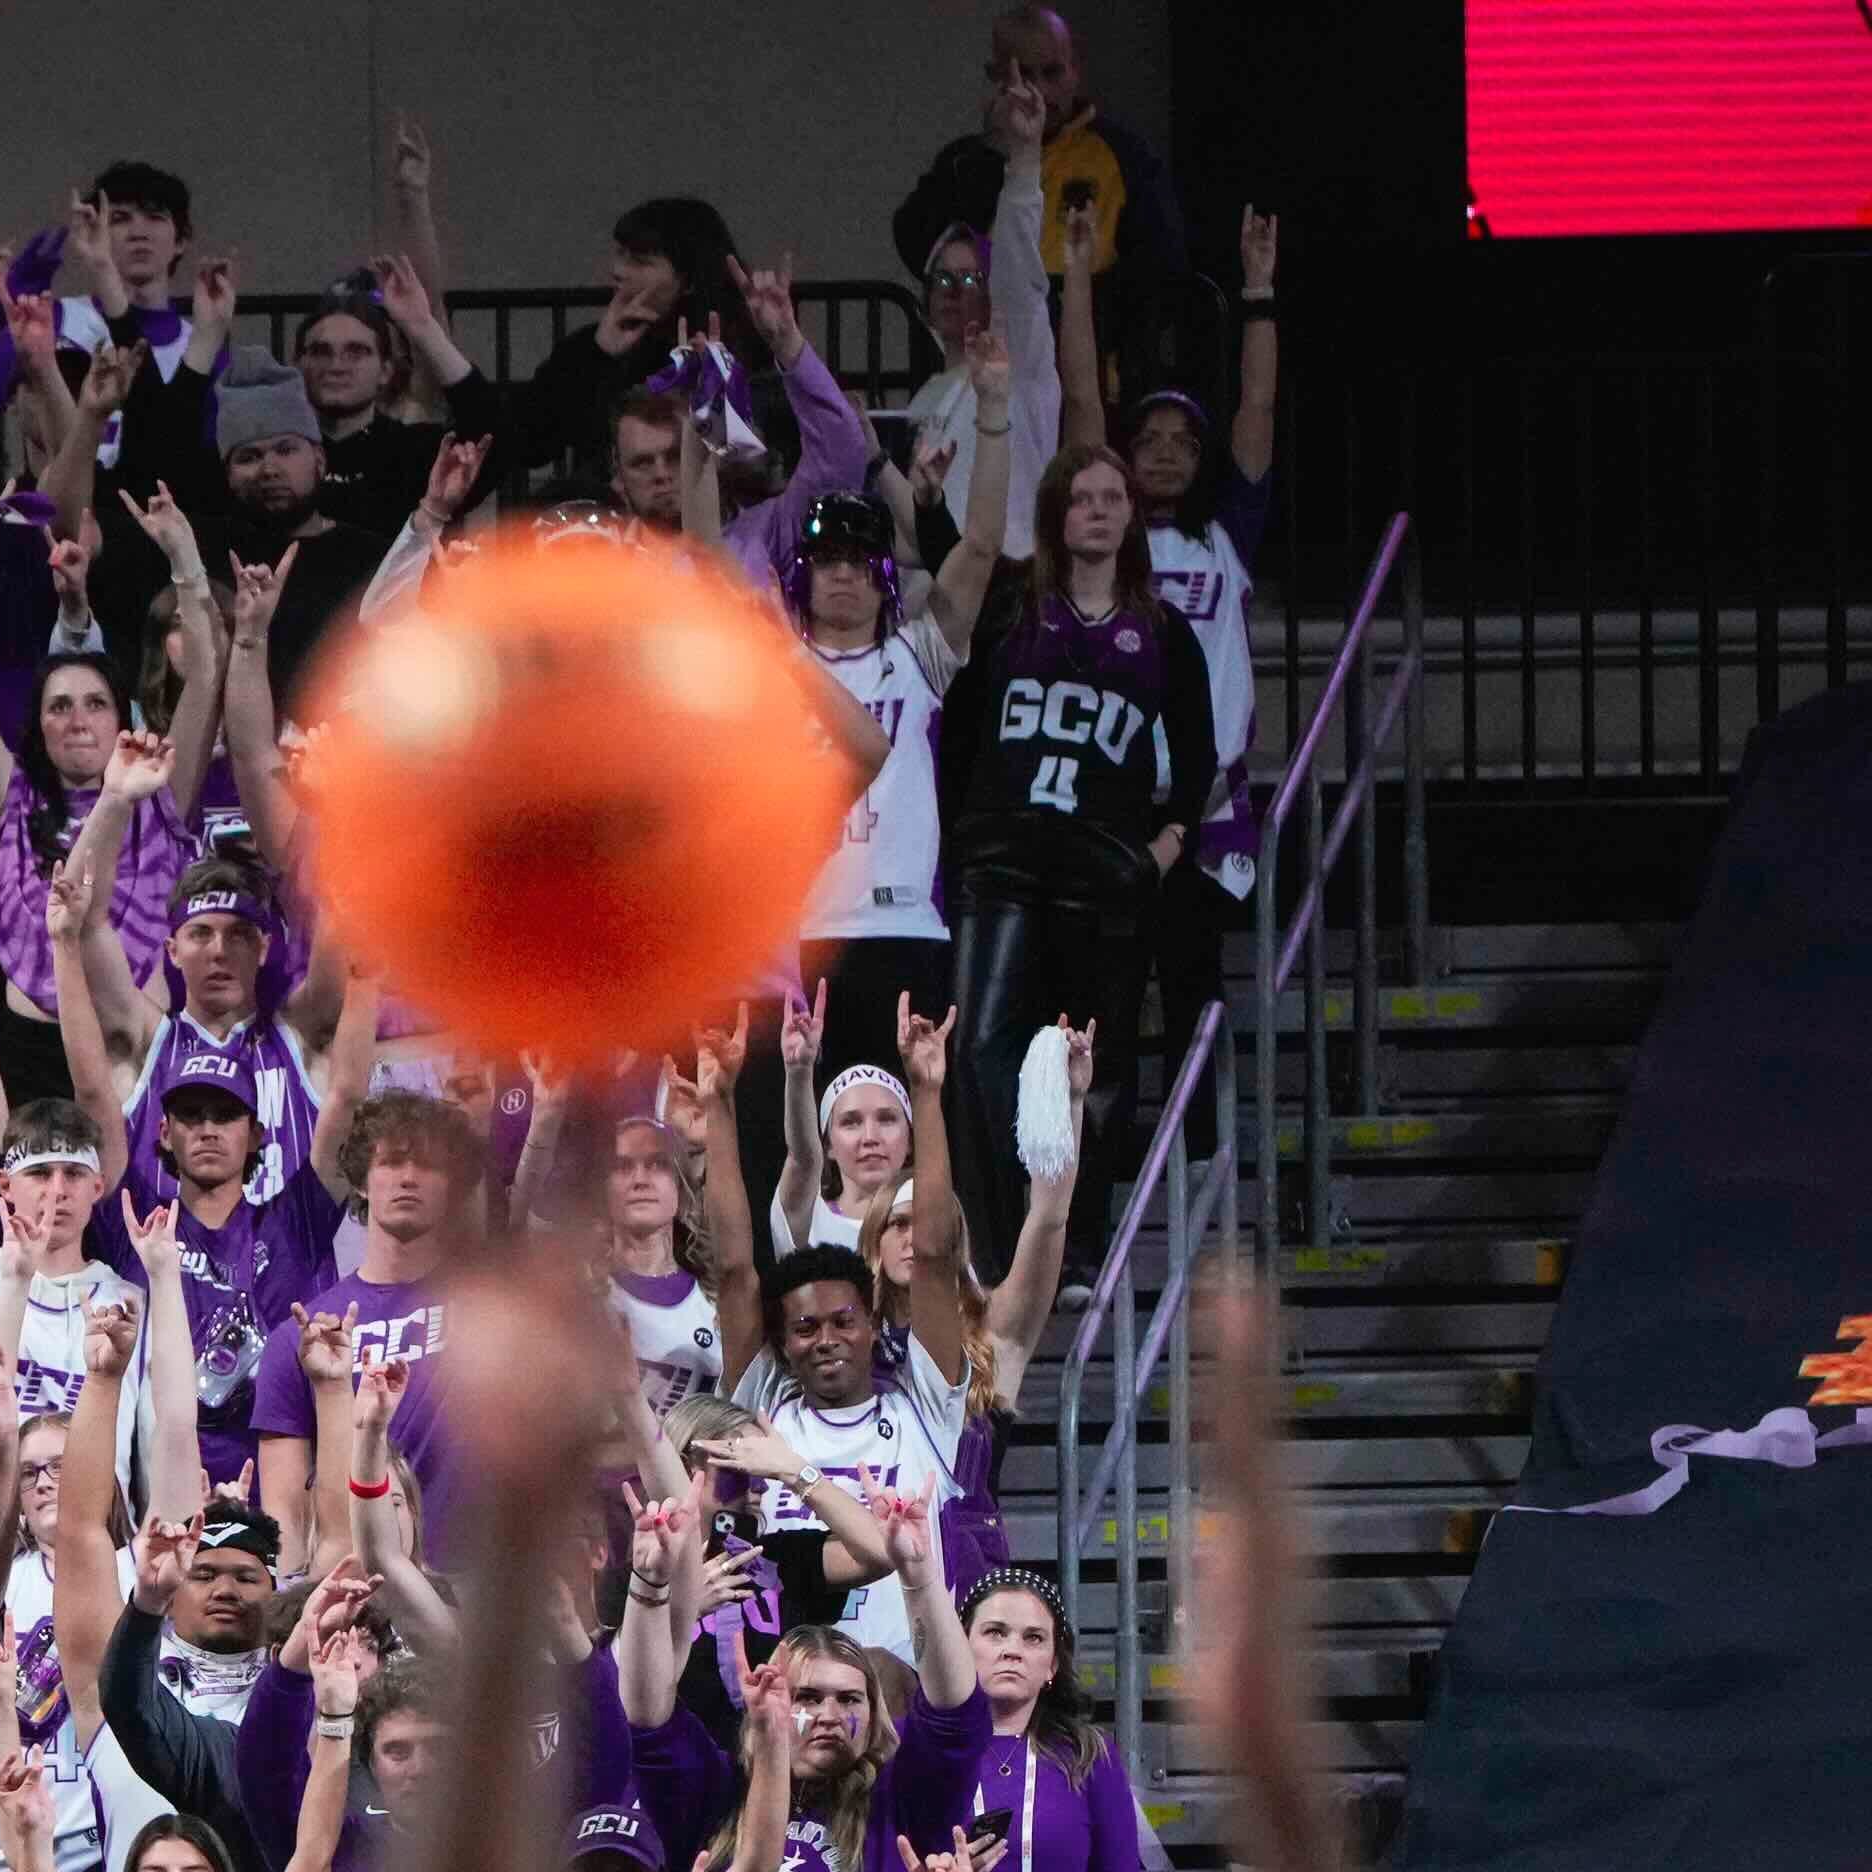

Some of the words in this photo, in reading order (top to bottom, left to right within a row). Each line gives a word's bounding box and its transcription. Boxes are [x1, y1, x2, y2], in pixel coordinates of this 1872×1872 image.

[999, 678, 1144, 766] GCU
[1029, 755, 1080, 815] 4
[187, 891, 236, 914] GCU
[178, 1055, 238, 1079] GCU
[576, 1814, 638, 1840] GCU
